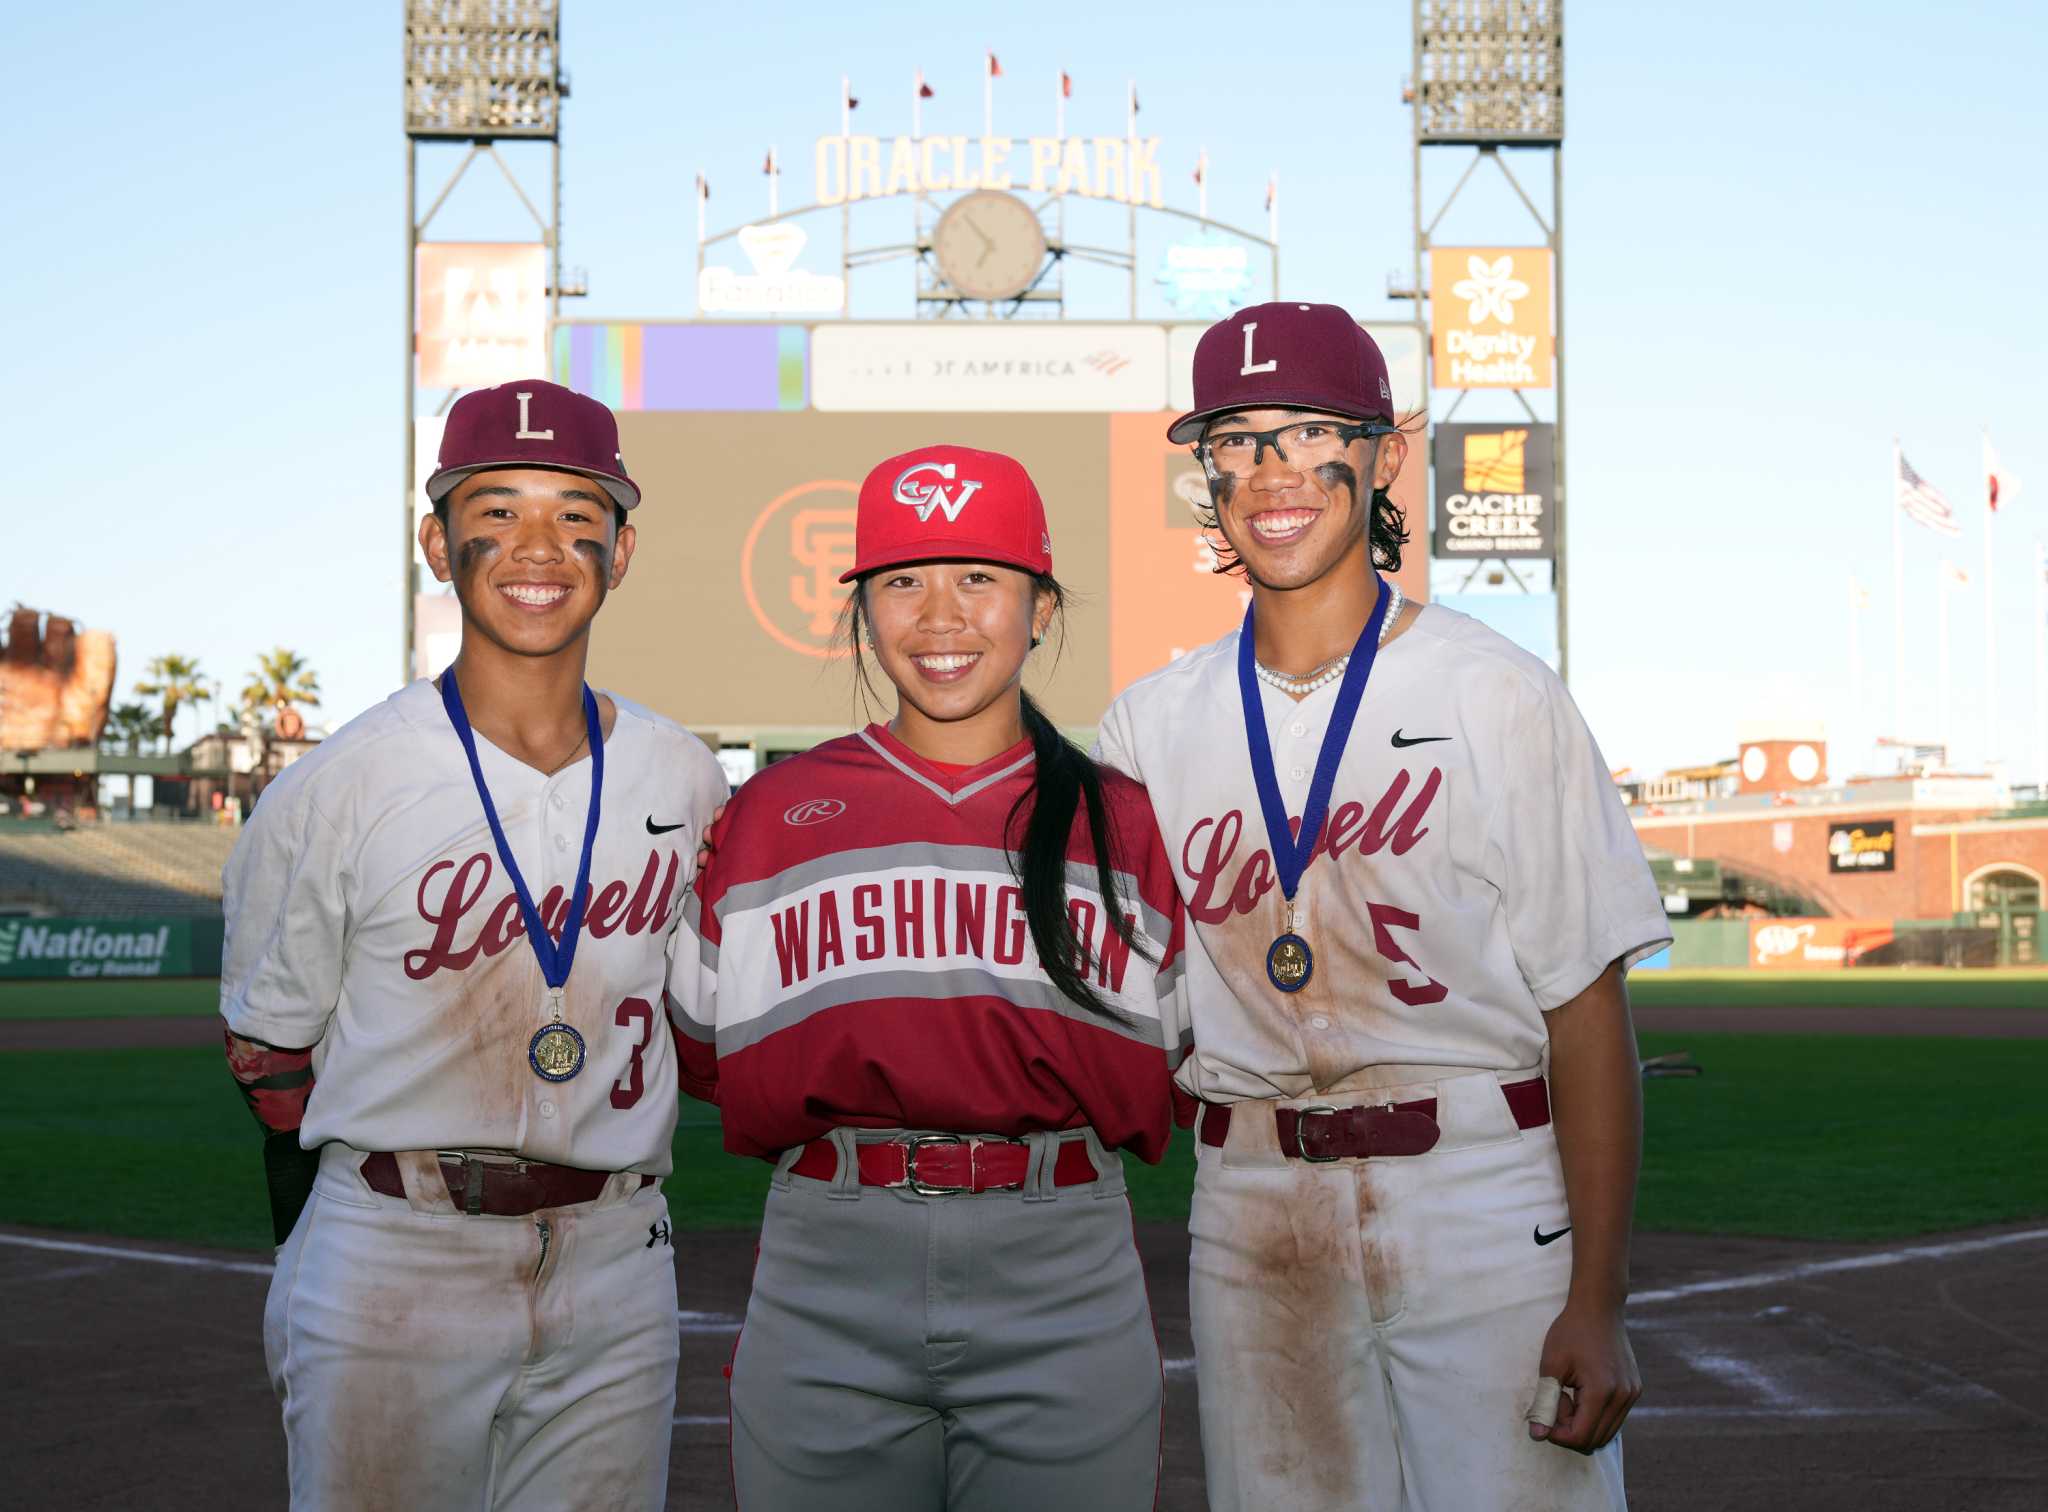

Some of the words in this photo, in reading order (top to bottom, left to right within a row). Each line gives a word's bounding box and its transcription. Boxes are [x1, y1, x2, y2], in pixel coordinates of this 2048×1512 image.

[815, 135, 1014, 206] ORACLE
[1028, 135, 1164, 209] PARK
[1240, 322, 1277, 376] L
[515, 392, 554, 440] L
[1446, 494, 1543, 515] CACHE
[1449, 515, 1540, 536] CREEK
[17, 925, 170, 959] National
[770, 876, 1138, 994] WASHINGON
[1366, 901, 1449, 1006] 5
[609, 997, 654, 1110] 3
